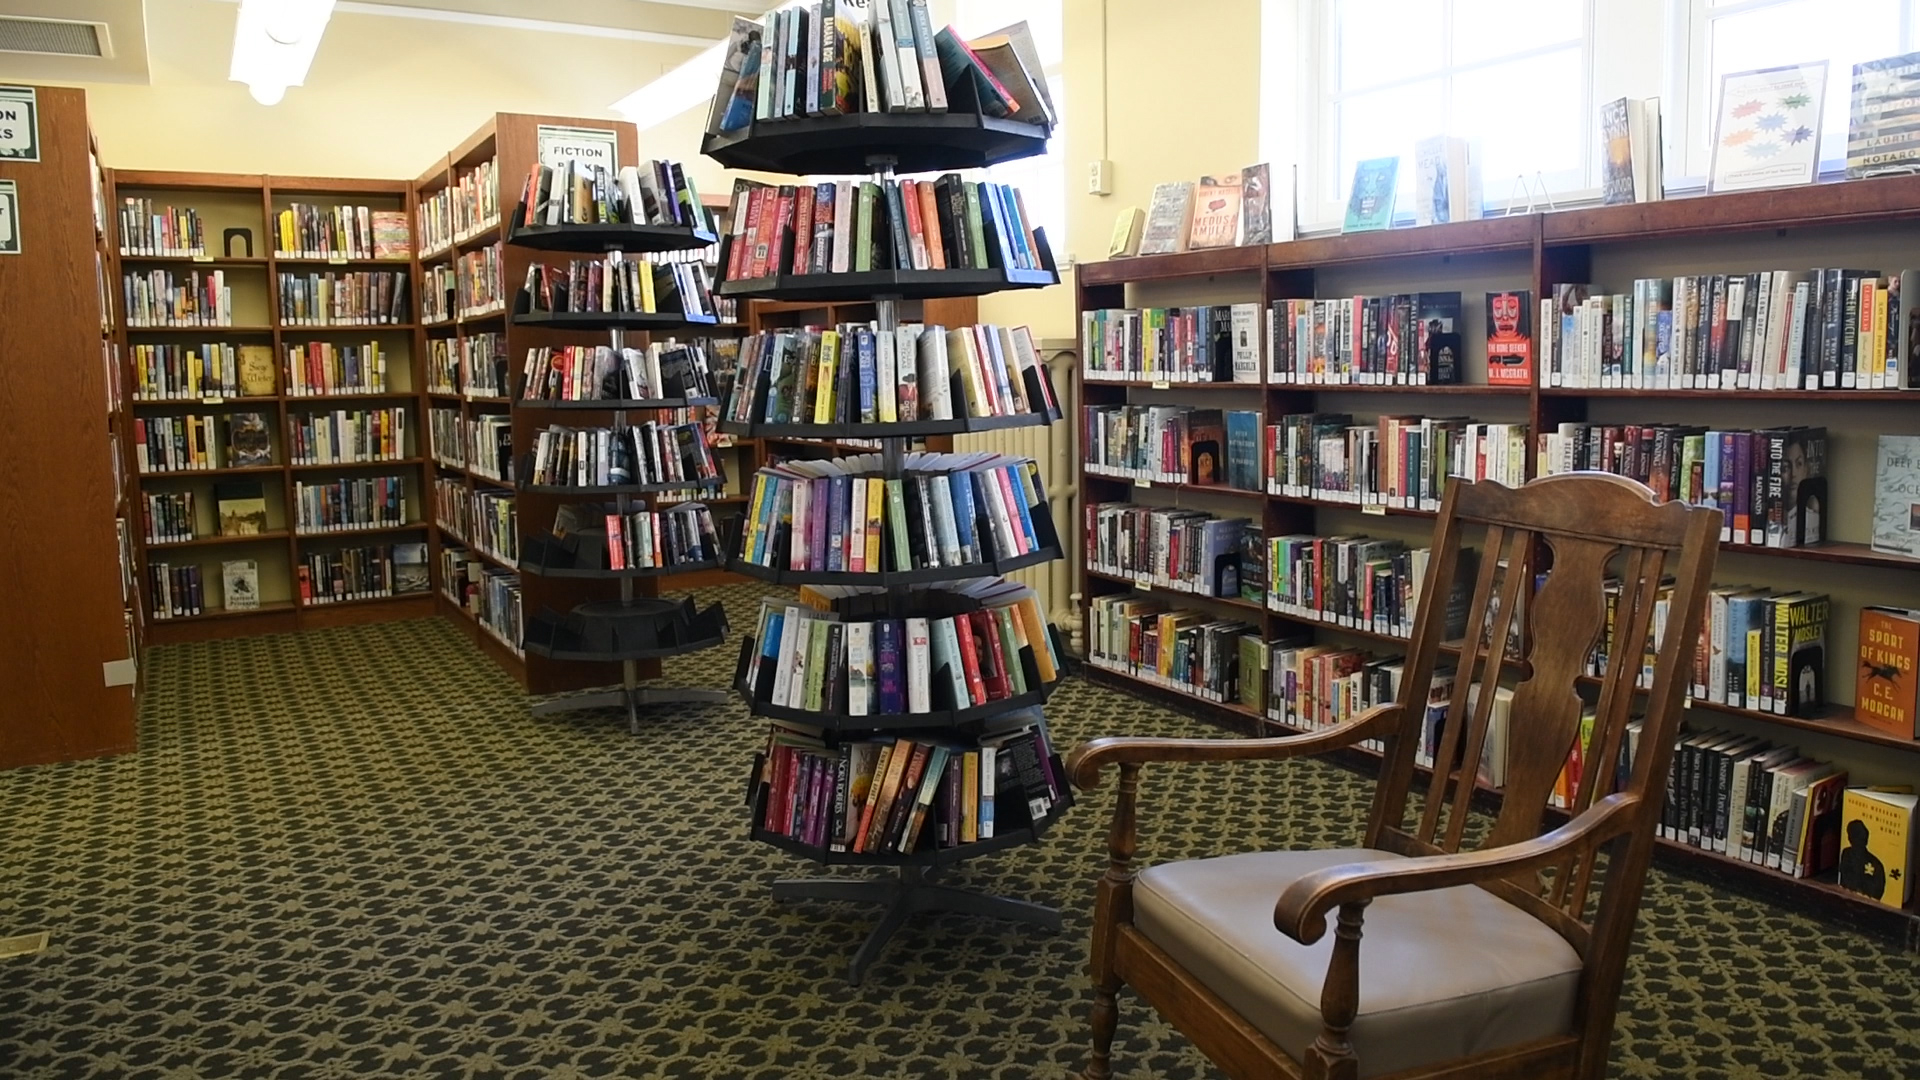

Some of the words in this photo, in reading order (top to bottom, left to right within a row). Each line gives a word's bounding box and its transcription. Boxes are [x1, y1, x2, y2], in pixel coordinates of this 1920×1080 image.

[1867, 133, 1913, 147] LAURIE
[554, 146, 603, 157] FICTION
[1863, 150, 1916, 164] NOTARO
[1193, 226, 1236, 236] AMULET
[1194, 215, 1238, 227] MEDUSA
[1758, 296, 1767, 315] LONG
[1844, 318, 1855, 346] VICTIM
[1653, 430, 1664, 466] MONING
[1770, 438, 1784, 459] INTO
[1771, 461, 1781, 476] THE
[1887, 456, 1913, 469] DEEP
[1755, 475, 1763, 515] BADLANDS
[1768, 476, 1782, 498] FIRE
[1898, 483, 1920, 495] OCE
[1790, 601, 1829, 627] WALTER
[1881, 620, 1892, 629] THE
[1775, 604, 1789, 653] WALTER
[1794, 624, 1823, 642] MOSLEY
[1868, 628, 1904, 650] SPORT
[1861, 645, 1875, 660] OF
[1876, 650, 1912, 671] KINGS
[1774, 657, 1788, 688] MOSL
[1873, 682, 1883, 696] C.
[1885, 686, 1894, 701] E.
[1861, 696, 1905, 723] MORGAN
[837, 758, 848, 782] NORA
[835, 783, 846, 814] ROBERTS
[869, 783, 879, 800] APART
[1734, 804, 1744, 836] MUNRO
